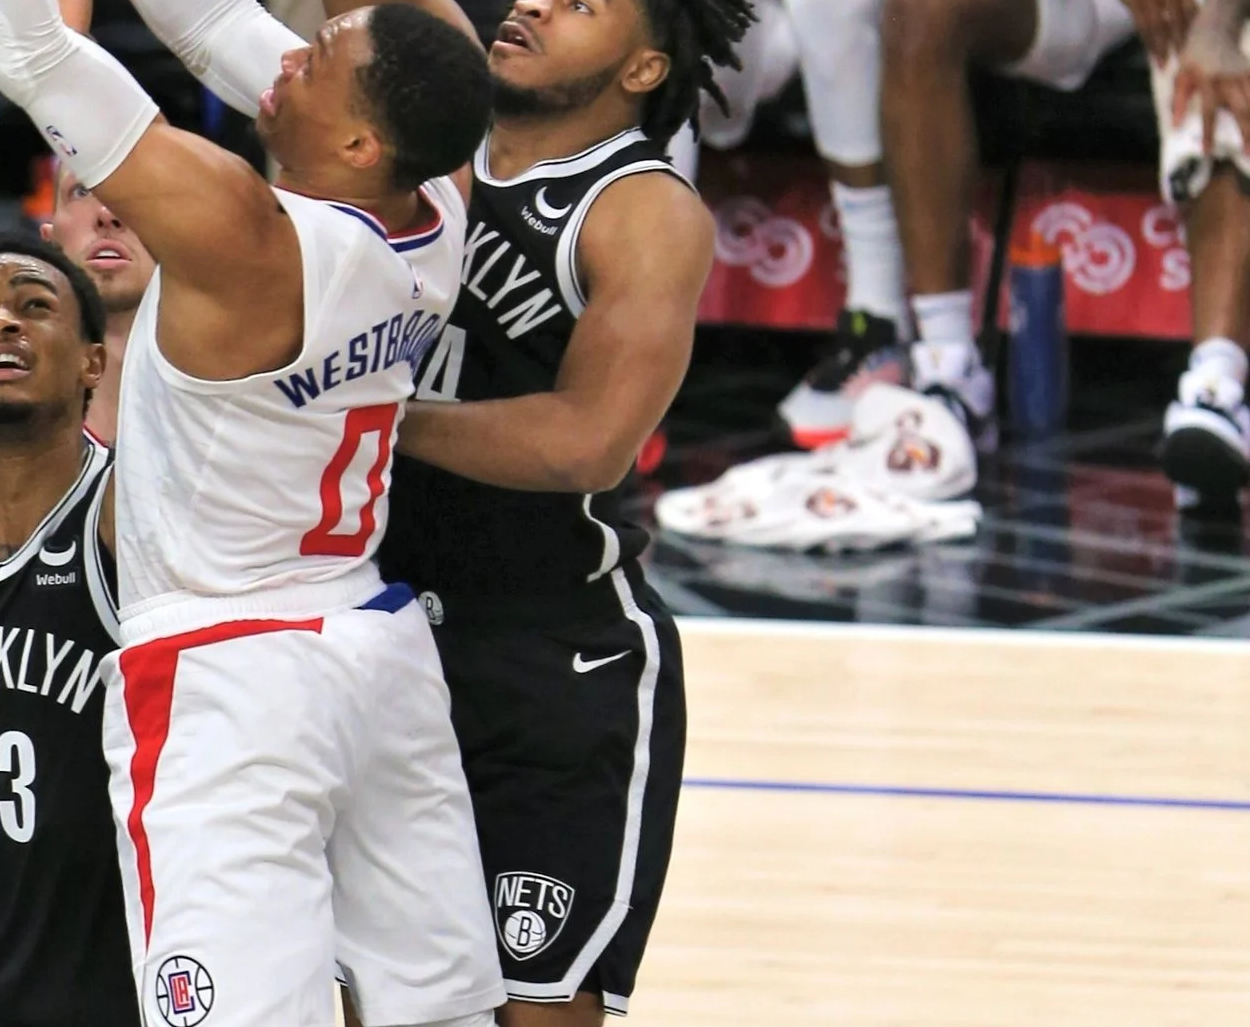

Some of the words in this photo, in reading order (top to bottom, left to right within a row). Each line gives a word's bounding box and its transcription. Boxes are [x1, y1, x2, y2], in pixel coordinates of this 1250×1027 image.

[521, 205, 558, 236] Webull
[461, 221, 562, 340] KLYN
[415, 323, 467, 402] 4
[299, 402, 399, 557] 0
[36, 572, 76, 586] Webull
[497, 876, 568, 920] NETS
